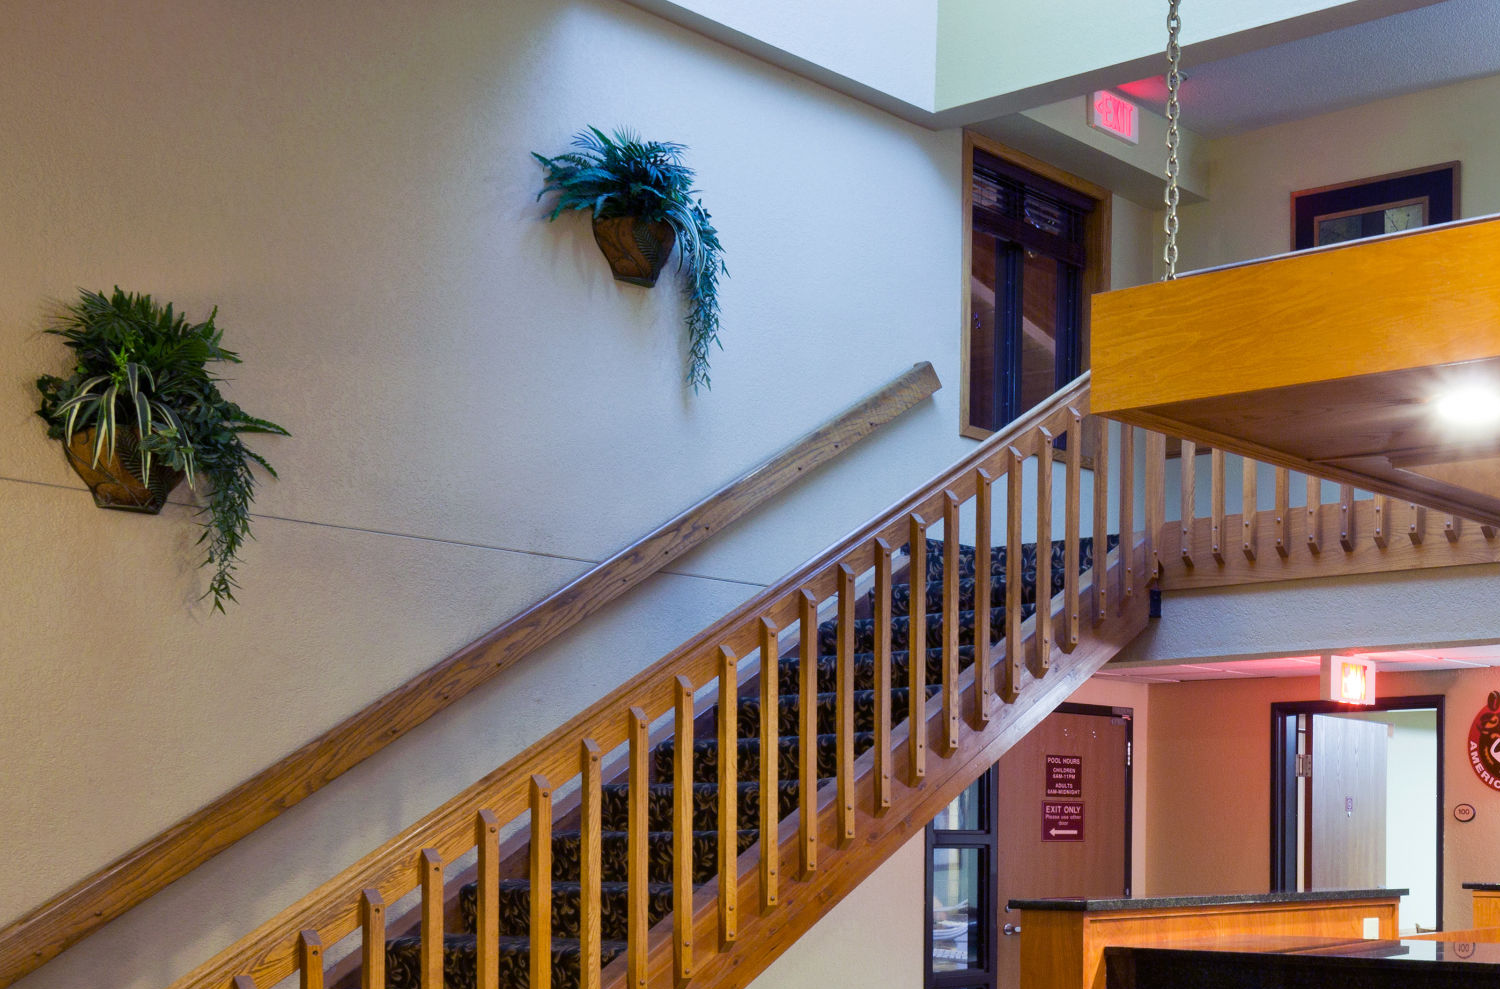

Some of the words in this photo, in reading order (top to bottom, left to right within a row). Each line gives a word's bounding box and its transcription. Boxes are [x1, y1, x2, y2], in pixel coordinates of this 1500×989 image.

[1102, 90, 1134, 137] EXIT
[1045, 805, 1062, 814] EXIT
[1063, 806, 1081, 814] ONLY
